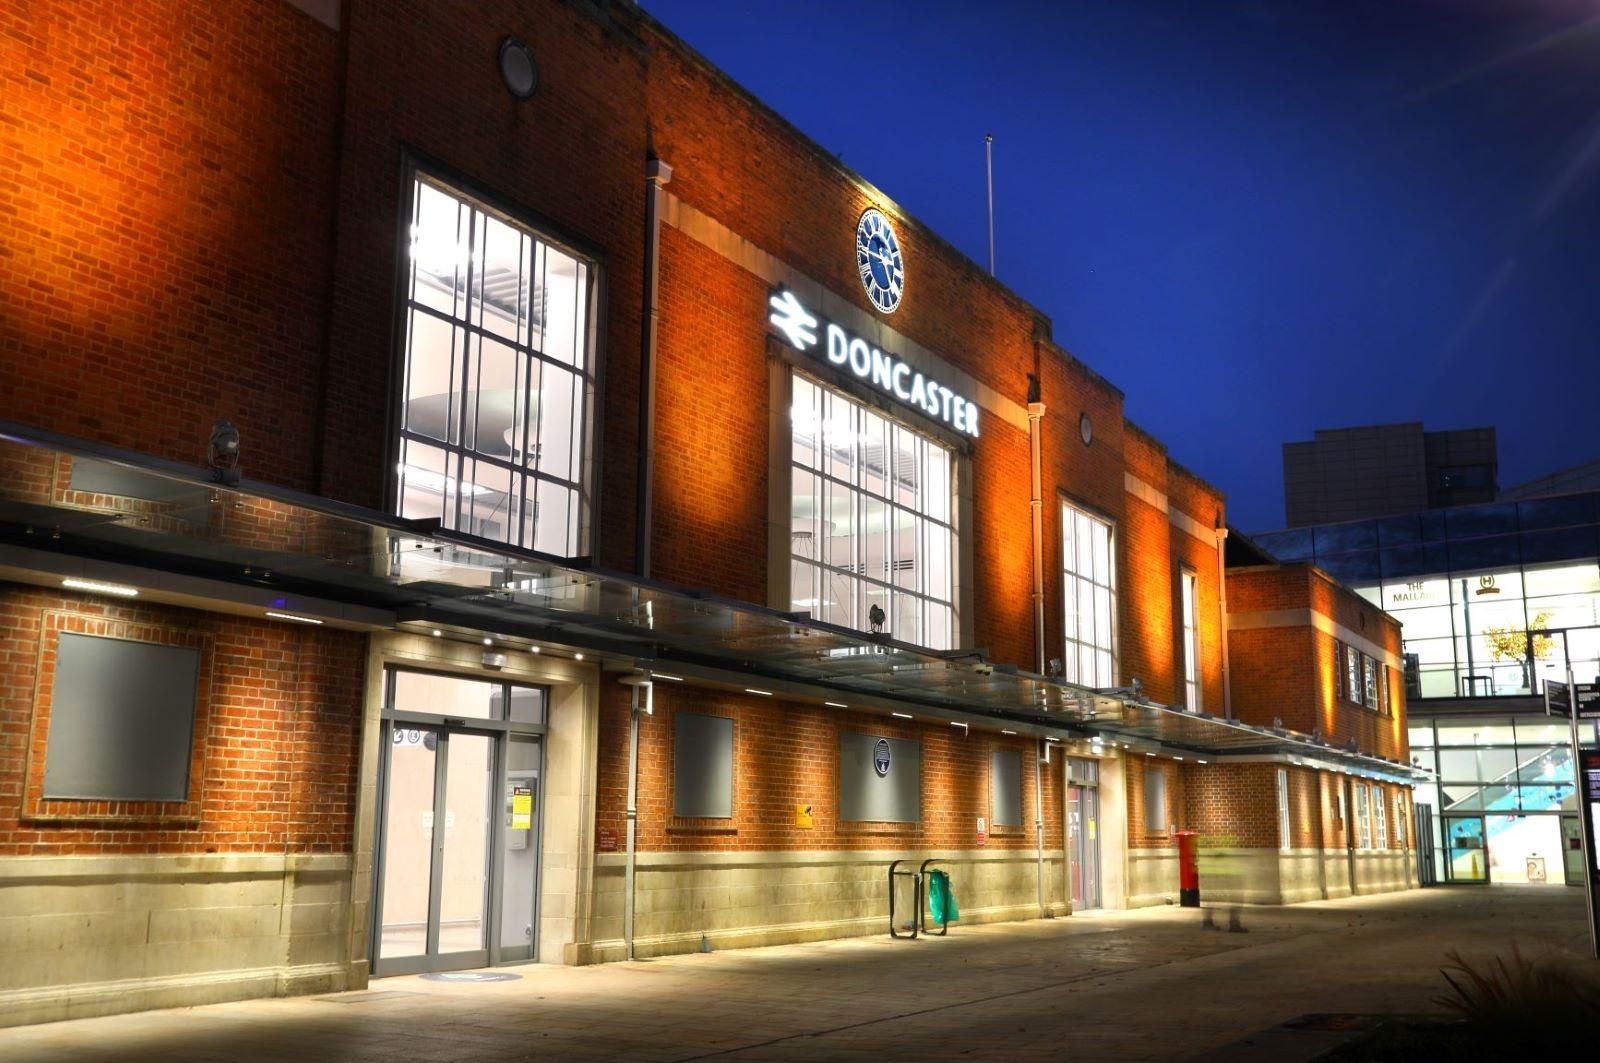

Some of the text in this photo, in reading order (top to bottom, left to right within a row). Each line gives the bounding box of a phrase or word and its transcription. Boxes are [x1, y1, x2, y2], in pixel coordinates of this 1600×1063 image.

[827, 323, 980, 438] DONCASTER
[1406, 582, 1424, 591] THE
[1393, 592, 1437, 602] MALLA
